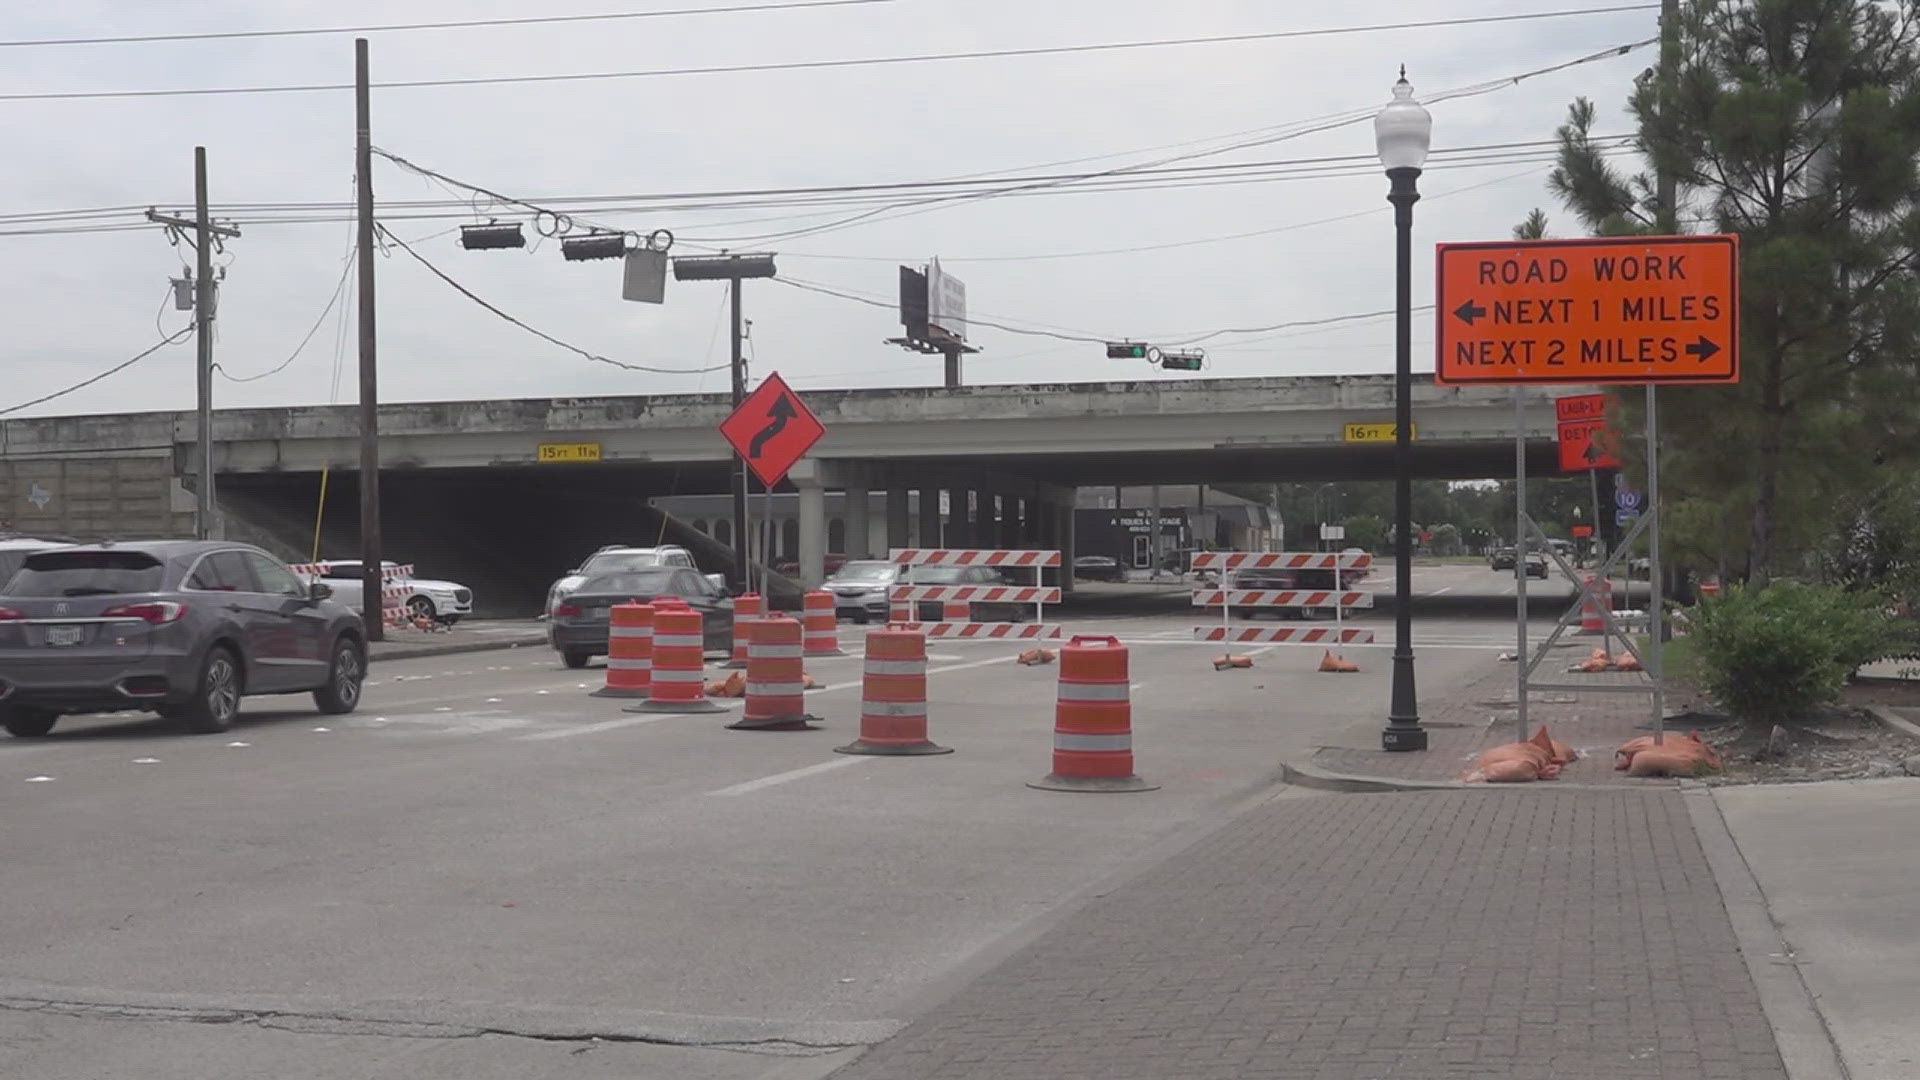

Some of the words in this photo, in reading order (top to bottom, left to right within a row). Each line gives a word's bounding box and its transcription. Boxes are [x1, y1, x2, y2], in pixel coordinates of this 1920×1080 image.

[1479, 258, 1568, 285] ROAD
[1594, 255, 1686, 281] WORK
[1493, 299, 1574, 325] NEXT
[1592, 299, 1600, 322] 1
[1623, 295, 1721, 322] MILES
[1456, 340, 1537, 366] NEXT
[1547, 340, 1566, 366] 2
[1580, 337, 1678, 363] MILES
[1621, 493, 1635, 506] 10
[1111, 518, 1144, 526] ATIQUES
